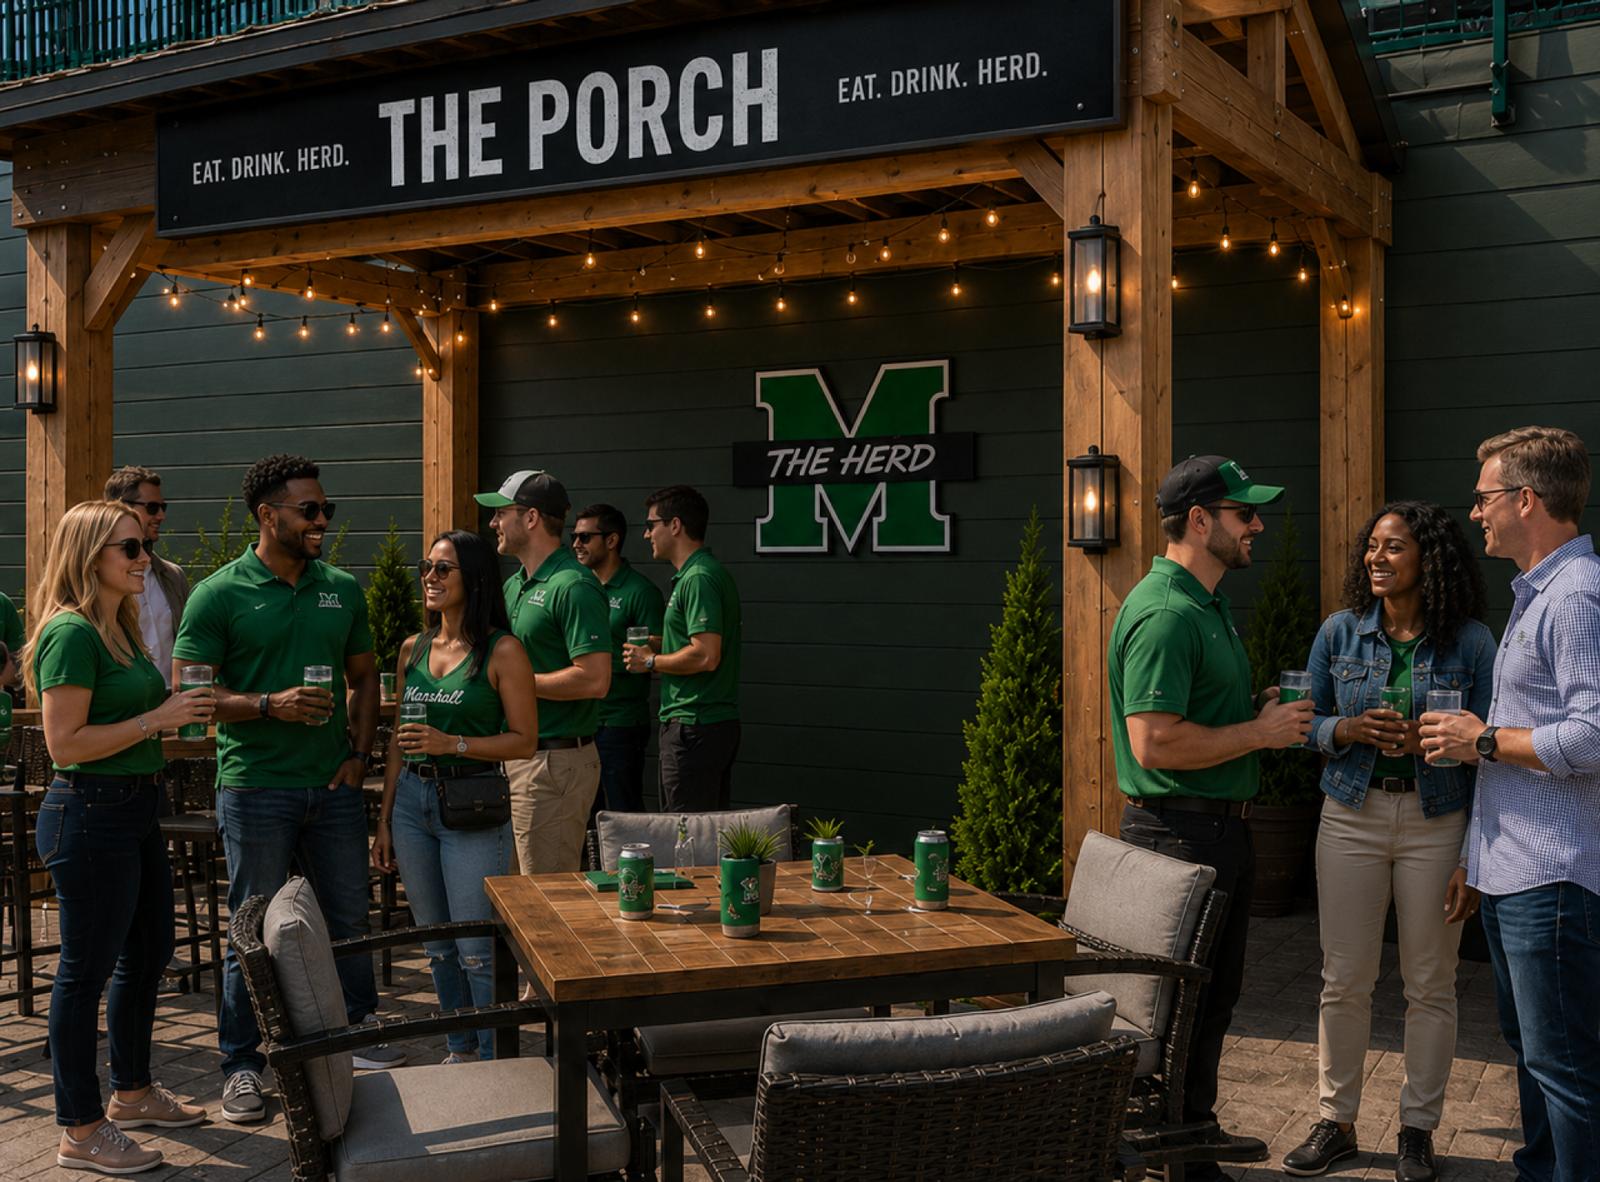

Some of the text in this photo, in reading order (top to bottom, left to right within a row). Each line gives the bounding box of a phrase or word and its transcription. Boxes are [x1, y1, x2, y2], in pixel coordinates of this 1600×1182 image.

[838, 52, 1048, 104] EAT. DRINK. HERD.
[378, 48, 779, 187] THE PORCH
[192, 144, 350, 185] EAT. DRINK. HERD.
[755, 359, 950, 553] M
[767, 444, 936, 478] THE HERD
